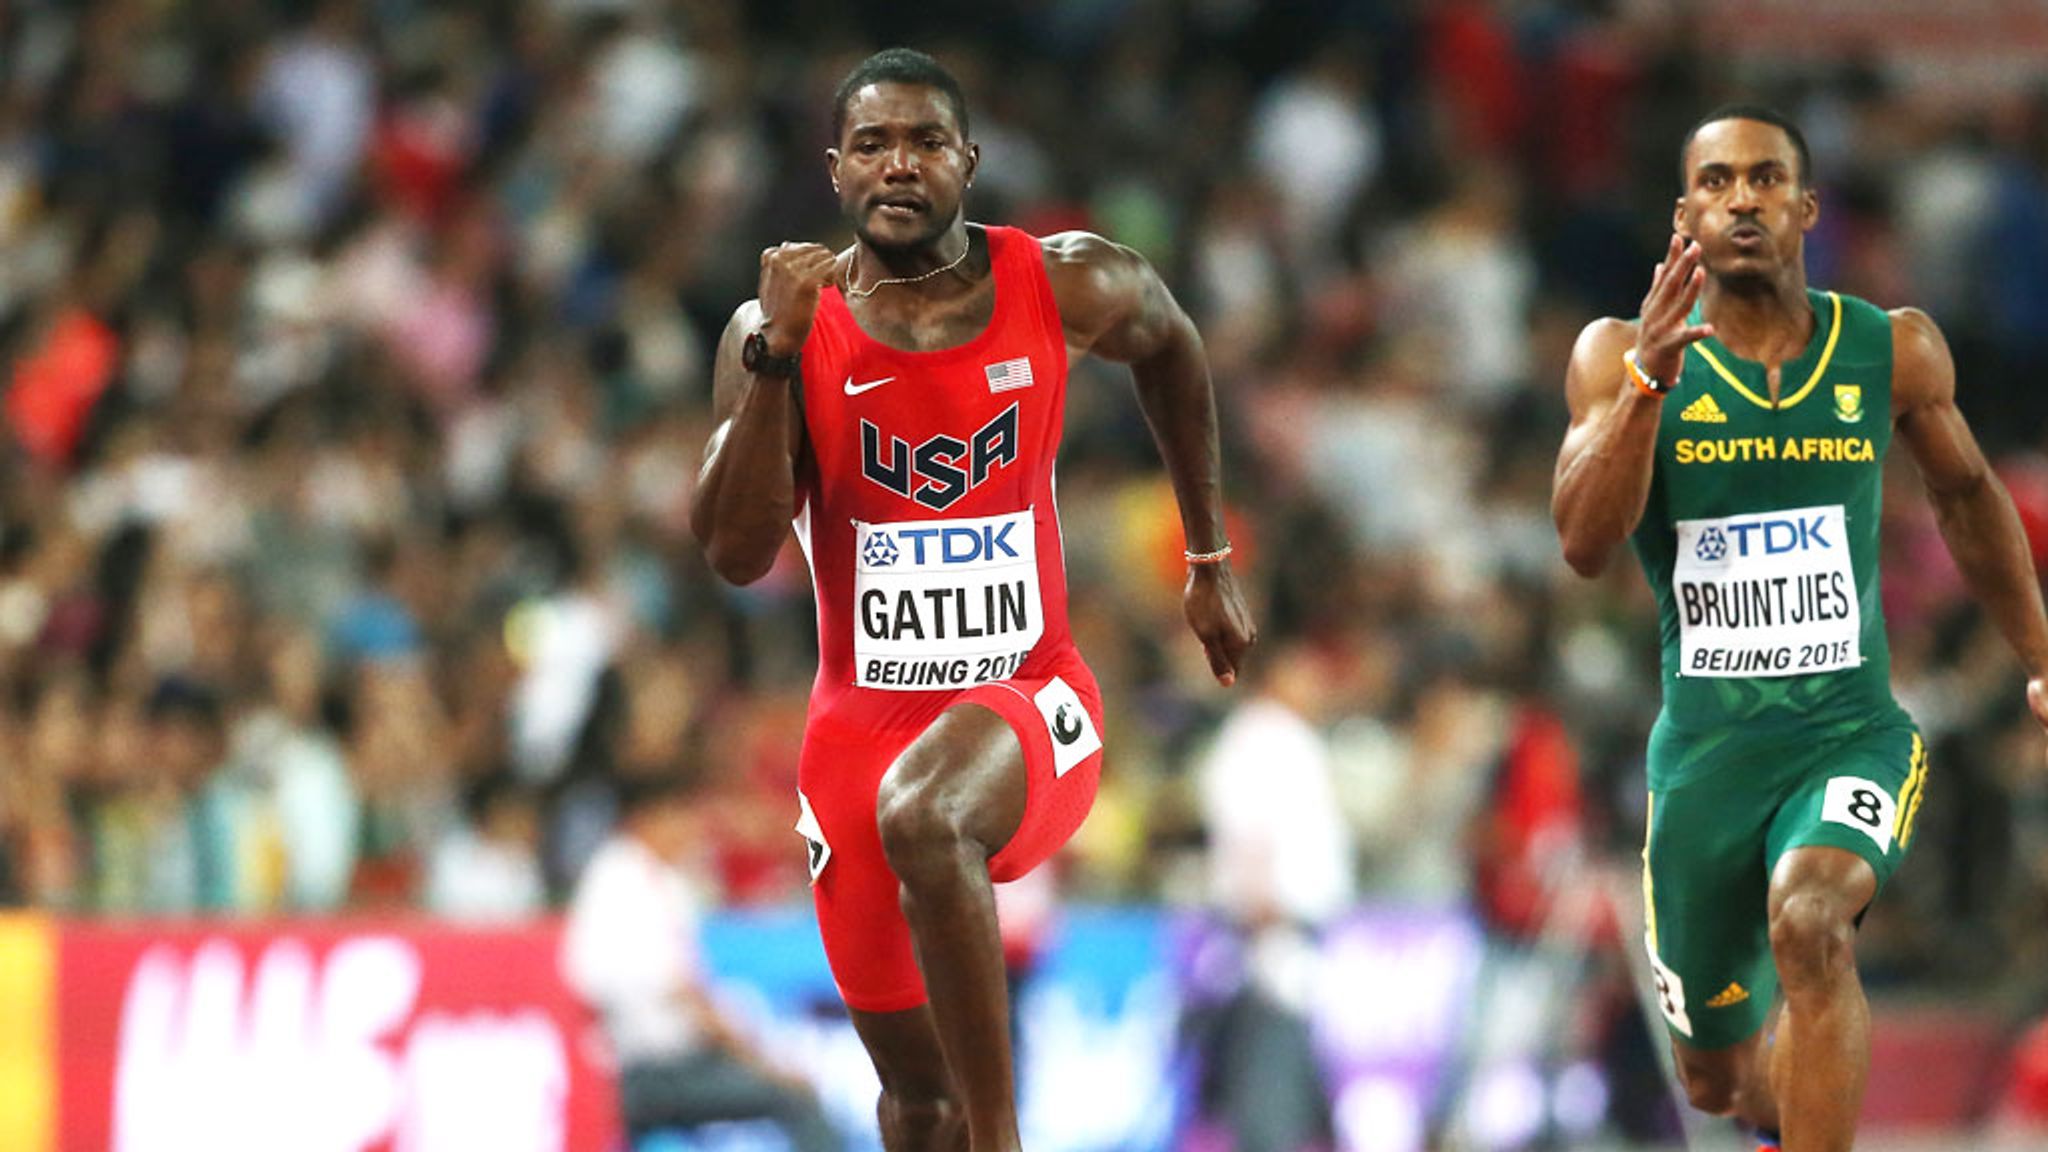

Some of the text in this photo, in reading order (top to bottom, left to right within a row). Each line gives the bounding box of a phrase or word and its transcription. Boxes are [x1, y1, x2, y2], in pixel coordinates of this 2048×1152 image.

[860, 400, 1019, 512] USA
[1675, 437, 1875, 463] SOUTH AFRICA
[898, 521, 1019, 565] TDK
[1728, 515, 1831, 557] TDK
[861, 580, 1028, 641] GATLIN
[1682, 571, 1849, 629] BRUINTJIES
[865, 659, 969, 685] BEIJING
[1691, 640, 1850, 671] BEIJING 2015
[1848, 789, 1882, 827] 8
